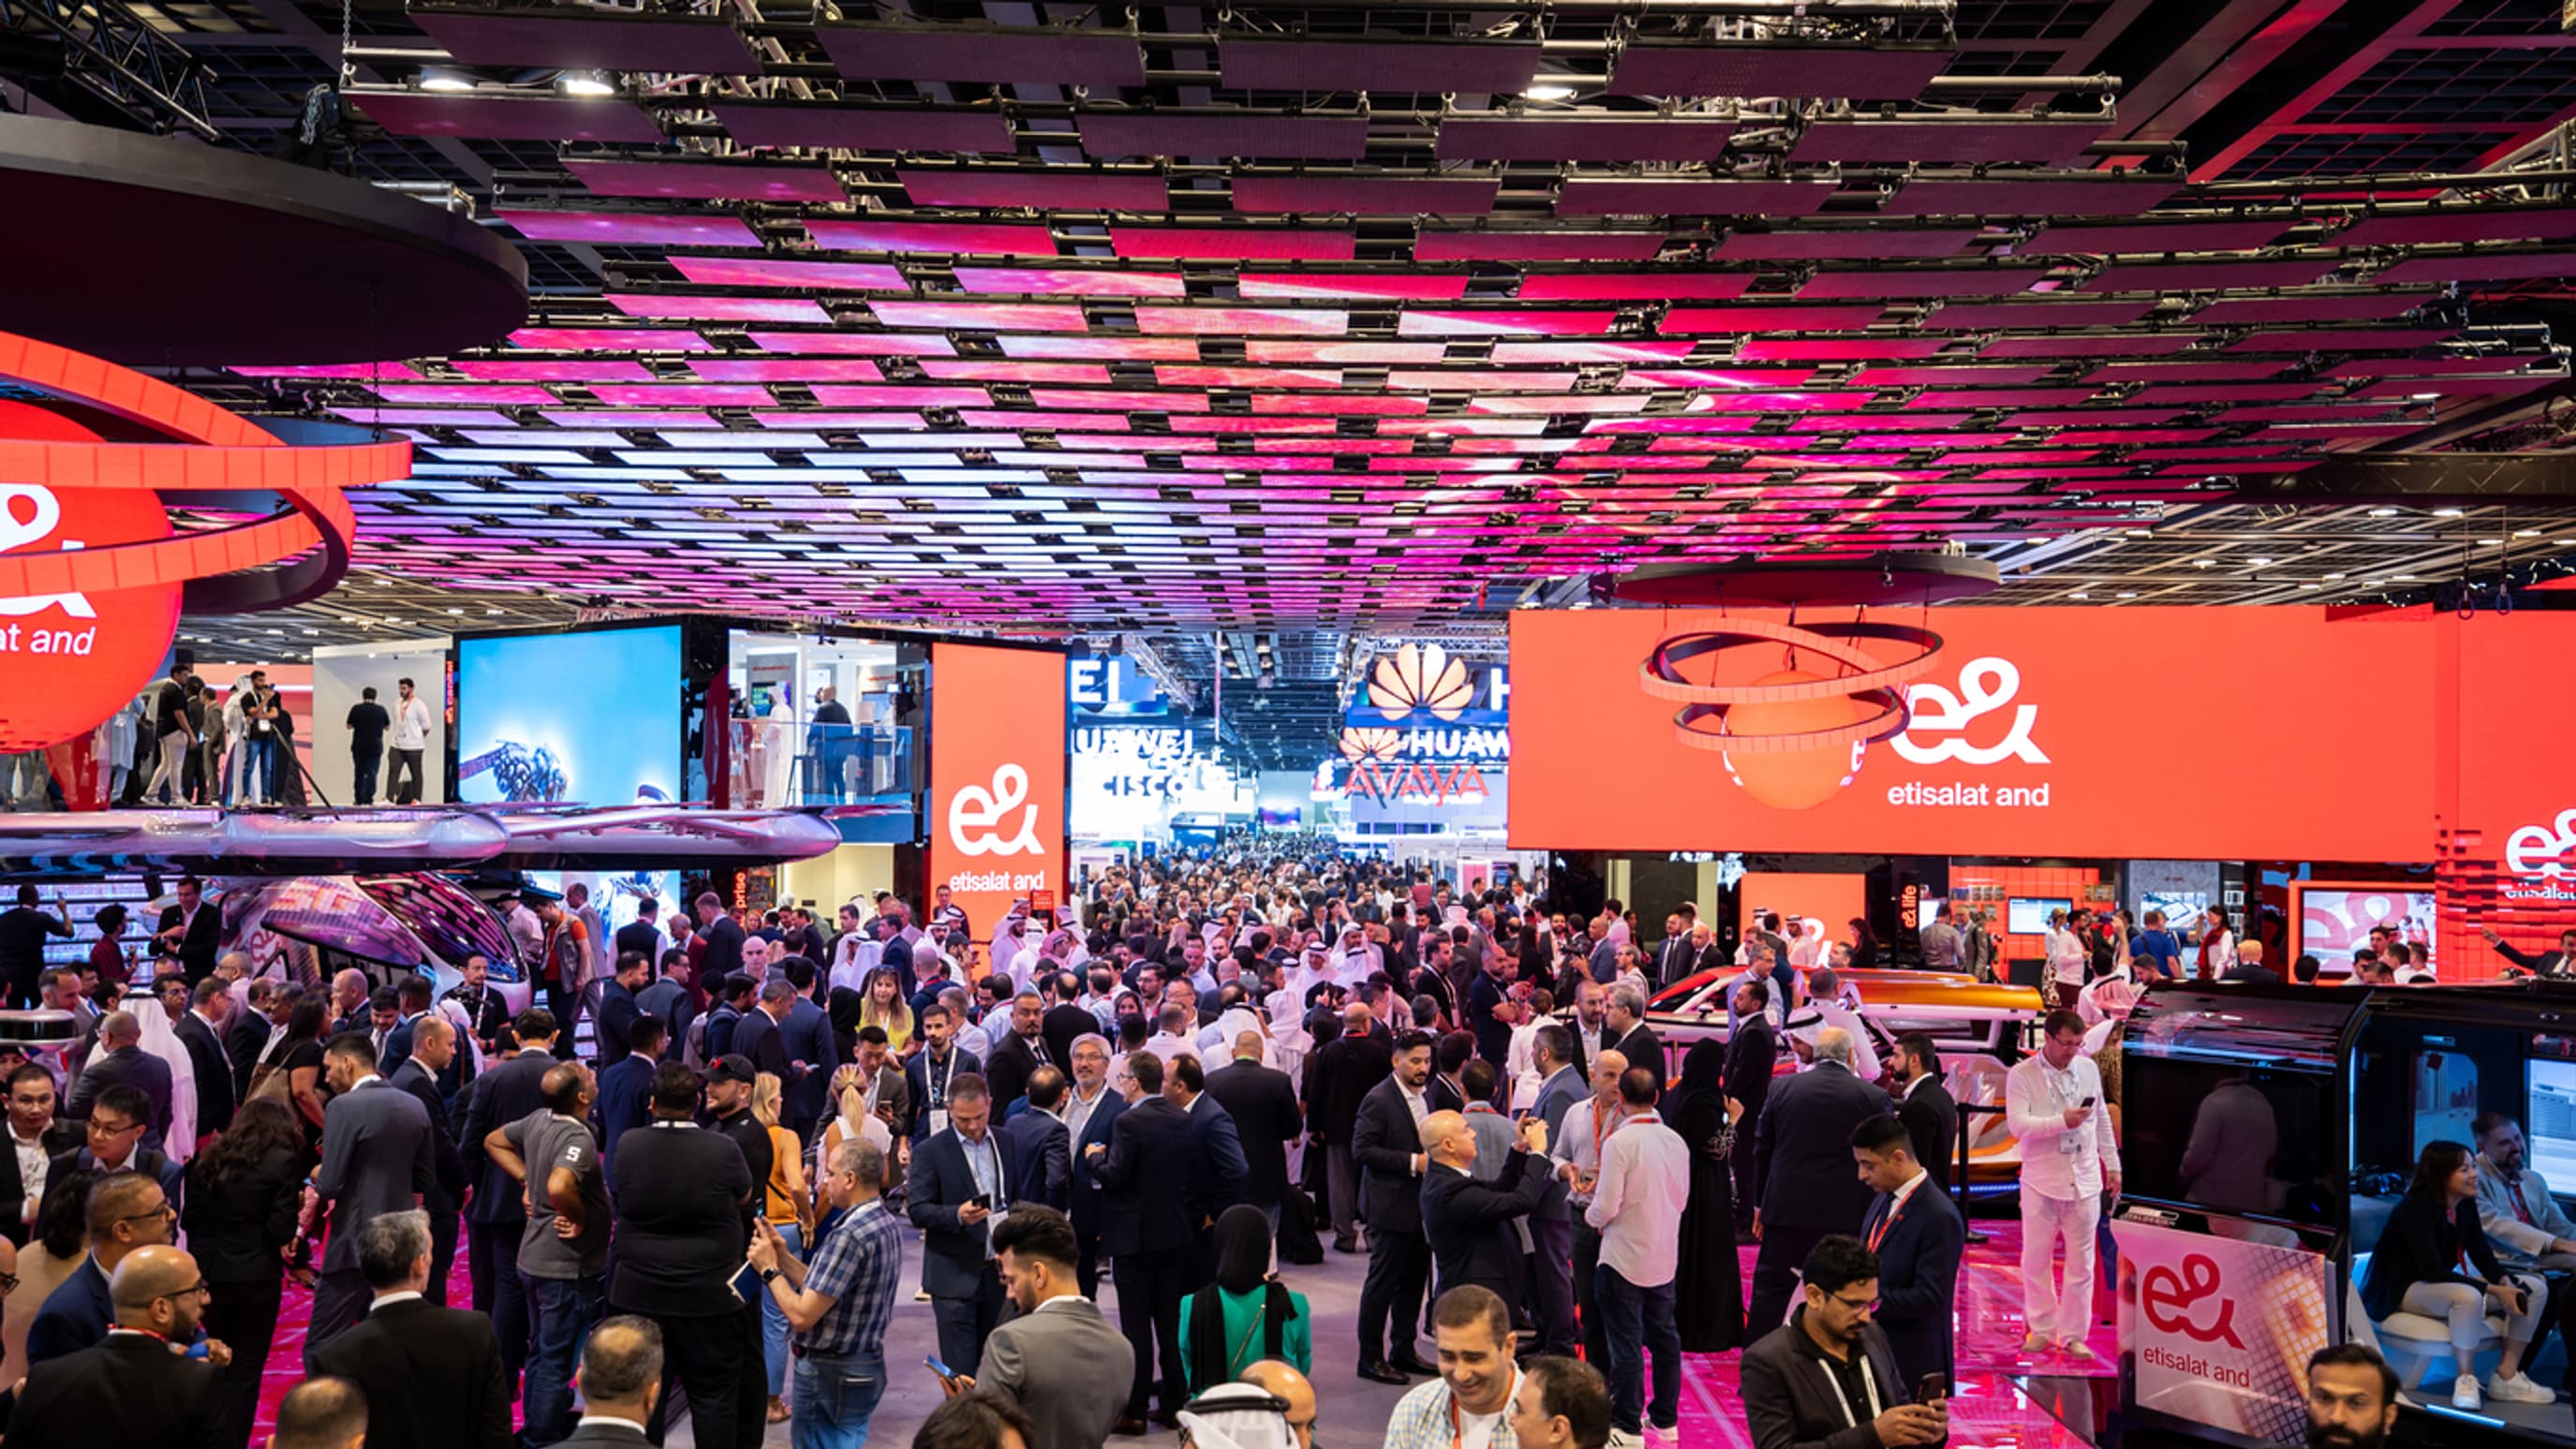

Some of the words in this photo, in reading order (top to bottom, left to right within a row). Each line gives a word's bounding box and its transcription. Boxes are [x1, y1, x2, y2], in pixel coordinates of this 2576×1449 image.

[30, 626, 96, 655] and
[1096, 775, 1191, 797] CISCO
[1344, 763, 1490, 807] AVAYA
[1888, 782, 1990, 806] etisalat
[1995, 783, 2050, 807] and
[948, 763, 1045, 856] e&
[949, 870, 1011, 892] etisalat
[1013, 869, 1045, 892] and
[2142, 1253, 2247, 1351] e&
[2143, 1347, 2209, 1378] etisalat
[2213, 1365, 2250, 1388] and
